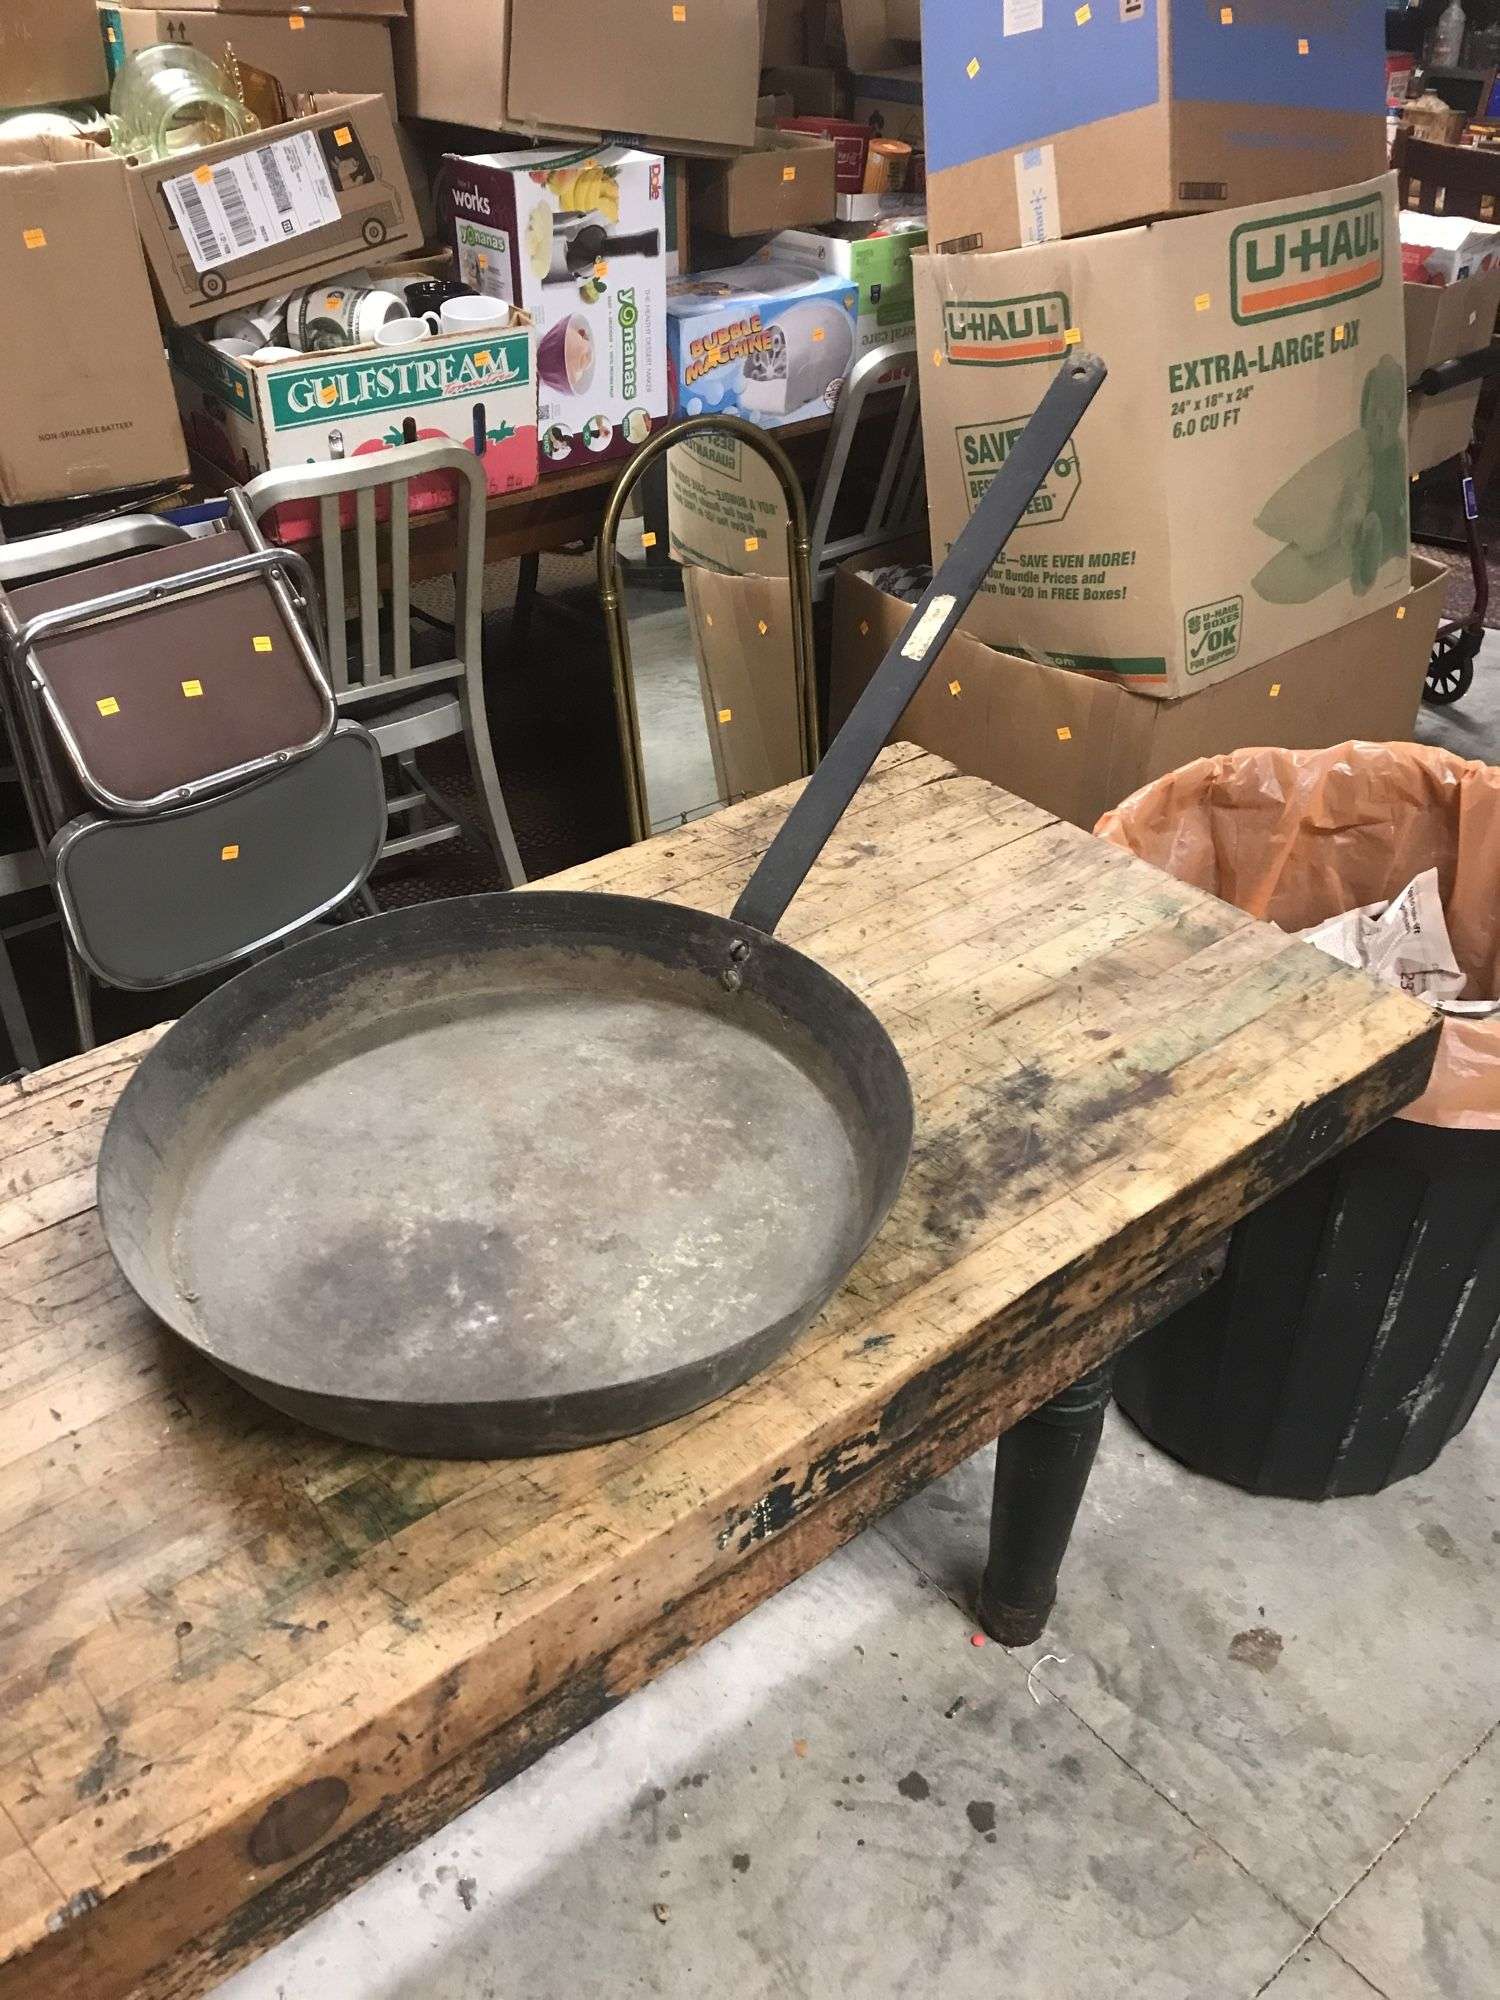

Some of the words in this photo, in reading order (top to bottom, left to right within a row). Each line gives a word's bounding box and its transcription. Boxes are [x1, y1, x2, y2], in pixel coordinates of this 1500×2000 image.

[451, 184, 491, 216] works
[1246, 211, 1380, 283] U-HAUL
[689, 314, 763, 358] BUBBLE
[948, 305, 1059, 342] U-HAUL
[617, 287, 638, 400] yonanas
[684, 329, 774, 387] MACHINE
[1168, 330, 1326, 394] EXTRA-LARGE
[286, 347, 514, 414] GULFSTREAM
[1172, 418, 1196, 439] 6.0
[1200, 411, 1219, 433] CU
[1223, 407, 1241, 428] FT
[1005, 569, 1040, 583] Bundle
[1043, 571, 1078, 584] Prices
[1081, 571, 1106, 584] and
[1052, 554, 1084, 569] EVEN
[1088, 550, 1137, 568] MORE!
[999, 582, 1016, 596] You
[1038, 586, 1048, 599] in
[1051, 587, 1080, 600] FREE
[1083, 586, 1127, 601] Boxes!
[1208, 624, 1237, 652] OK
